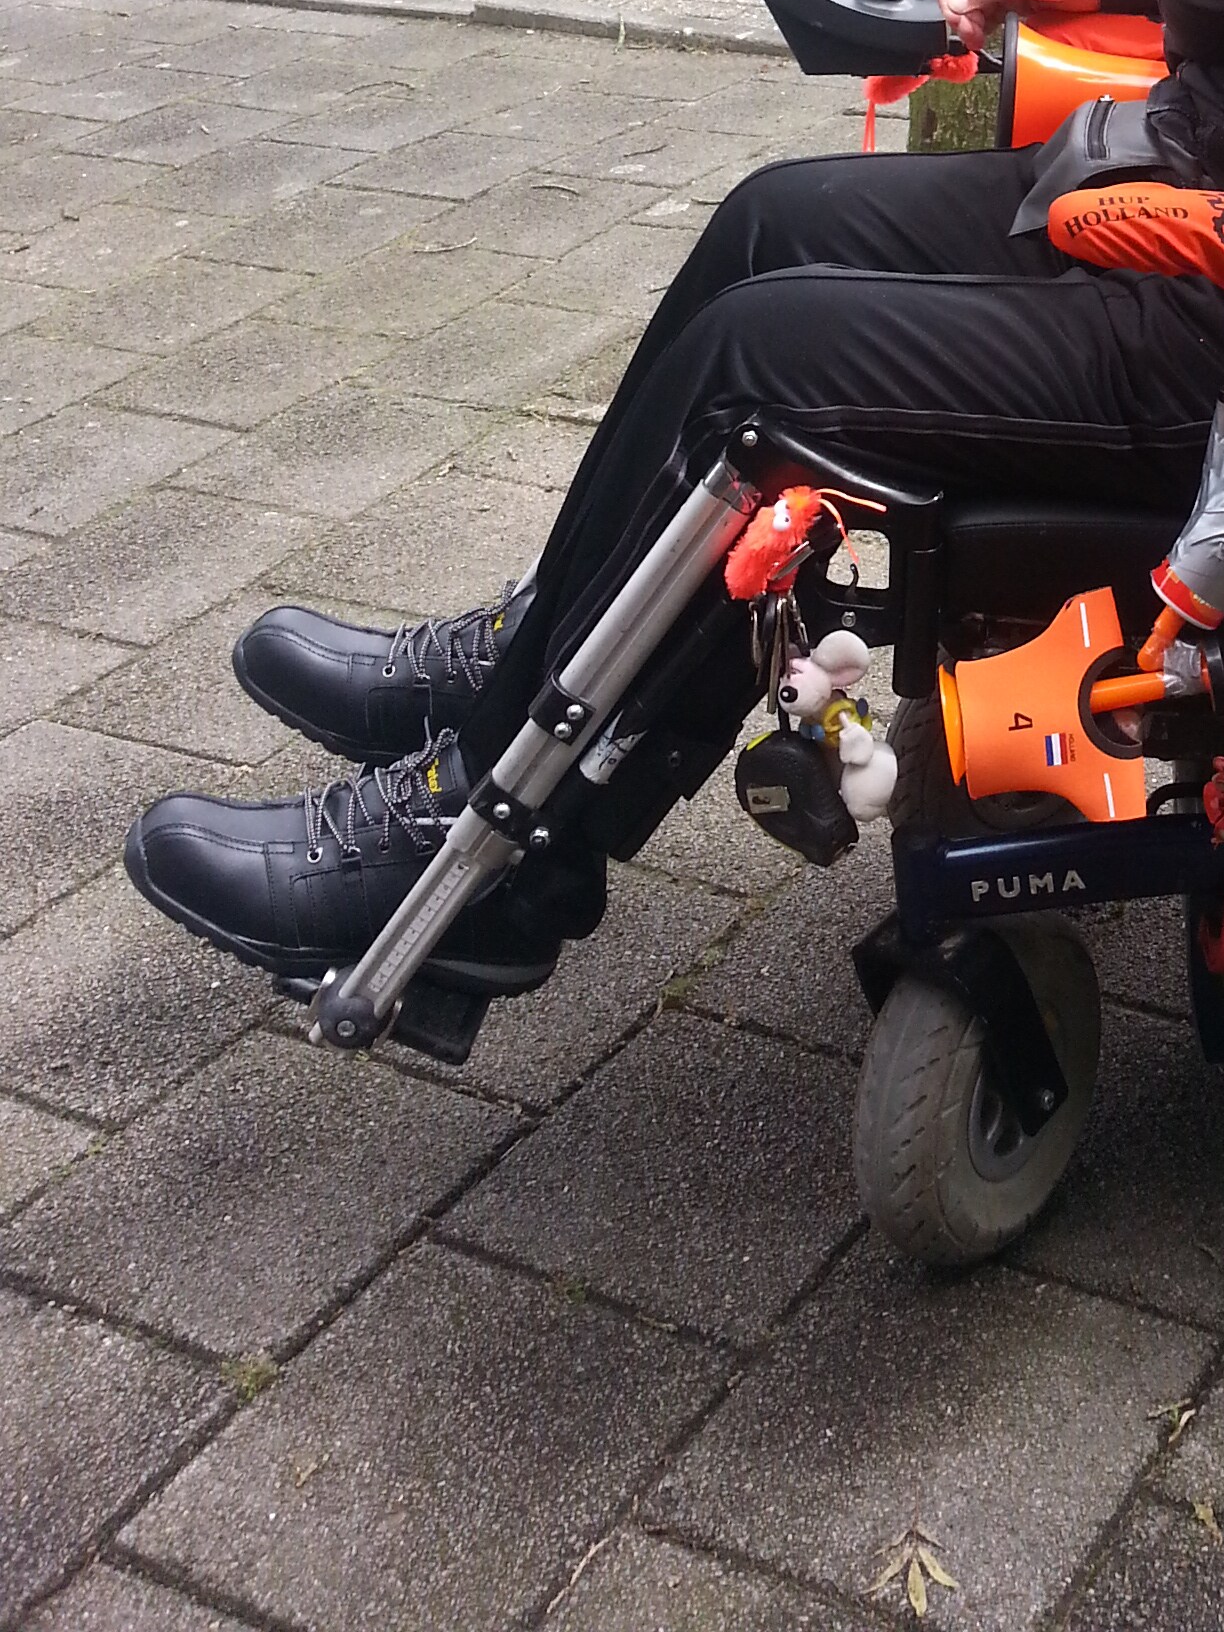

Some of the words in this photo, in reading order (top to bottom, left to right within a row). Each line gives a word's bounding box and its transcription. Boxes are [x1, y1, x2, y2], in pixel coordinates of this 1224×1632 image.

[1098, 196, 1150, 206] HUP
[1064, 206, 1189, 238] HOLLAND
[1008, 712, 1033, 731] 4
[971, 870, 1086, 902] PUMA
